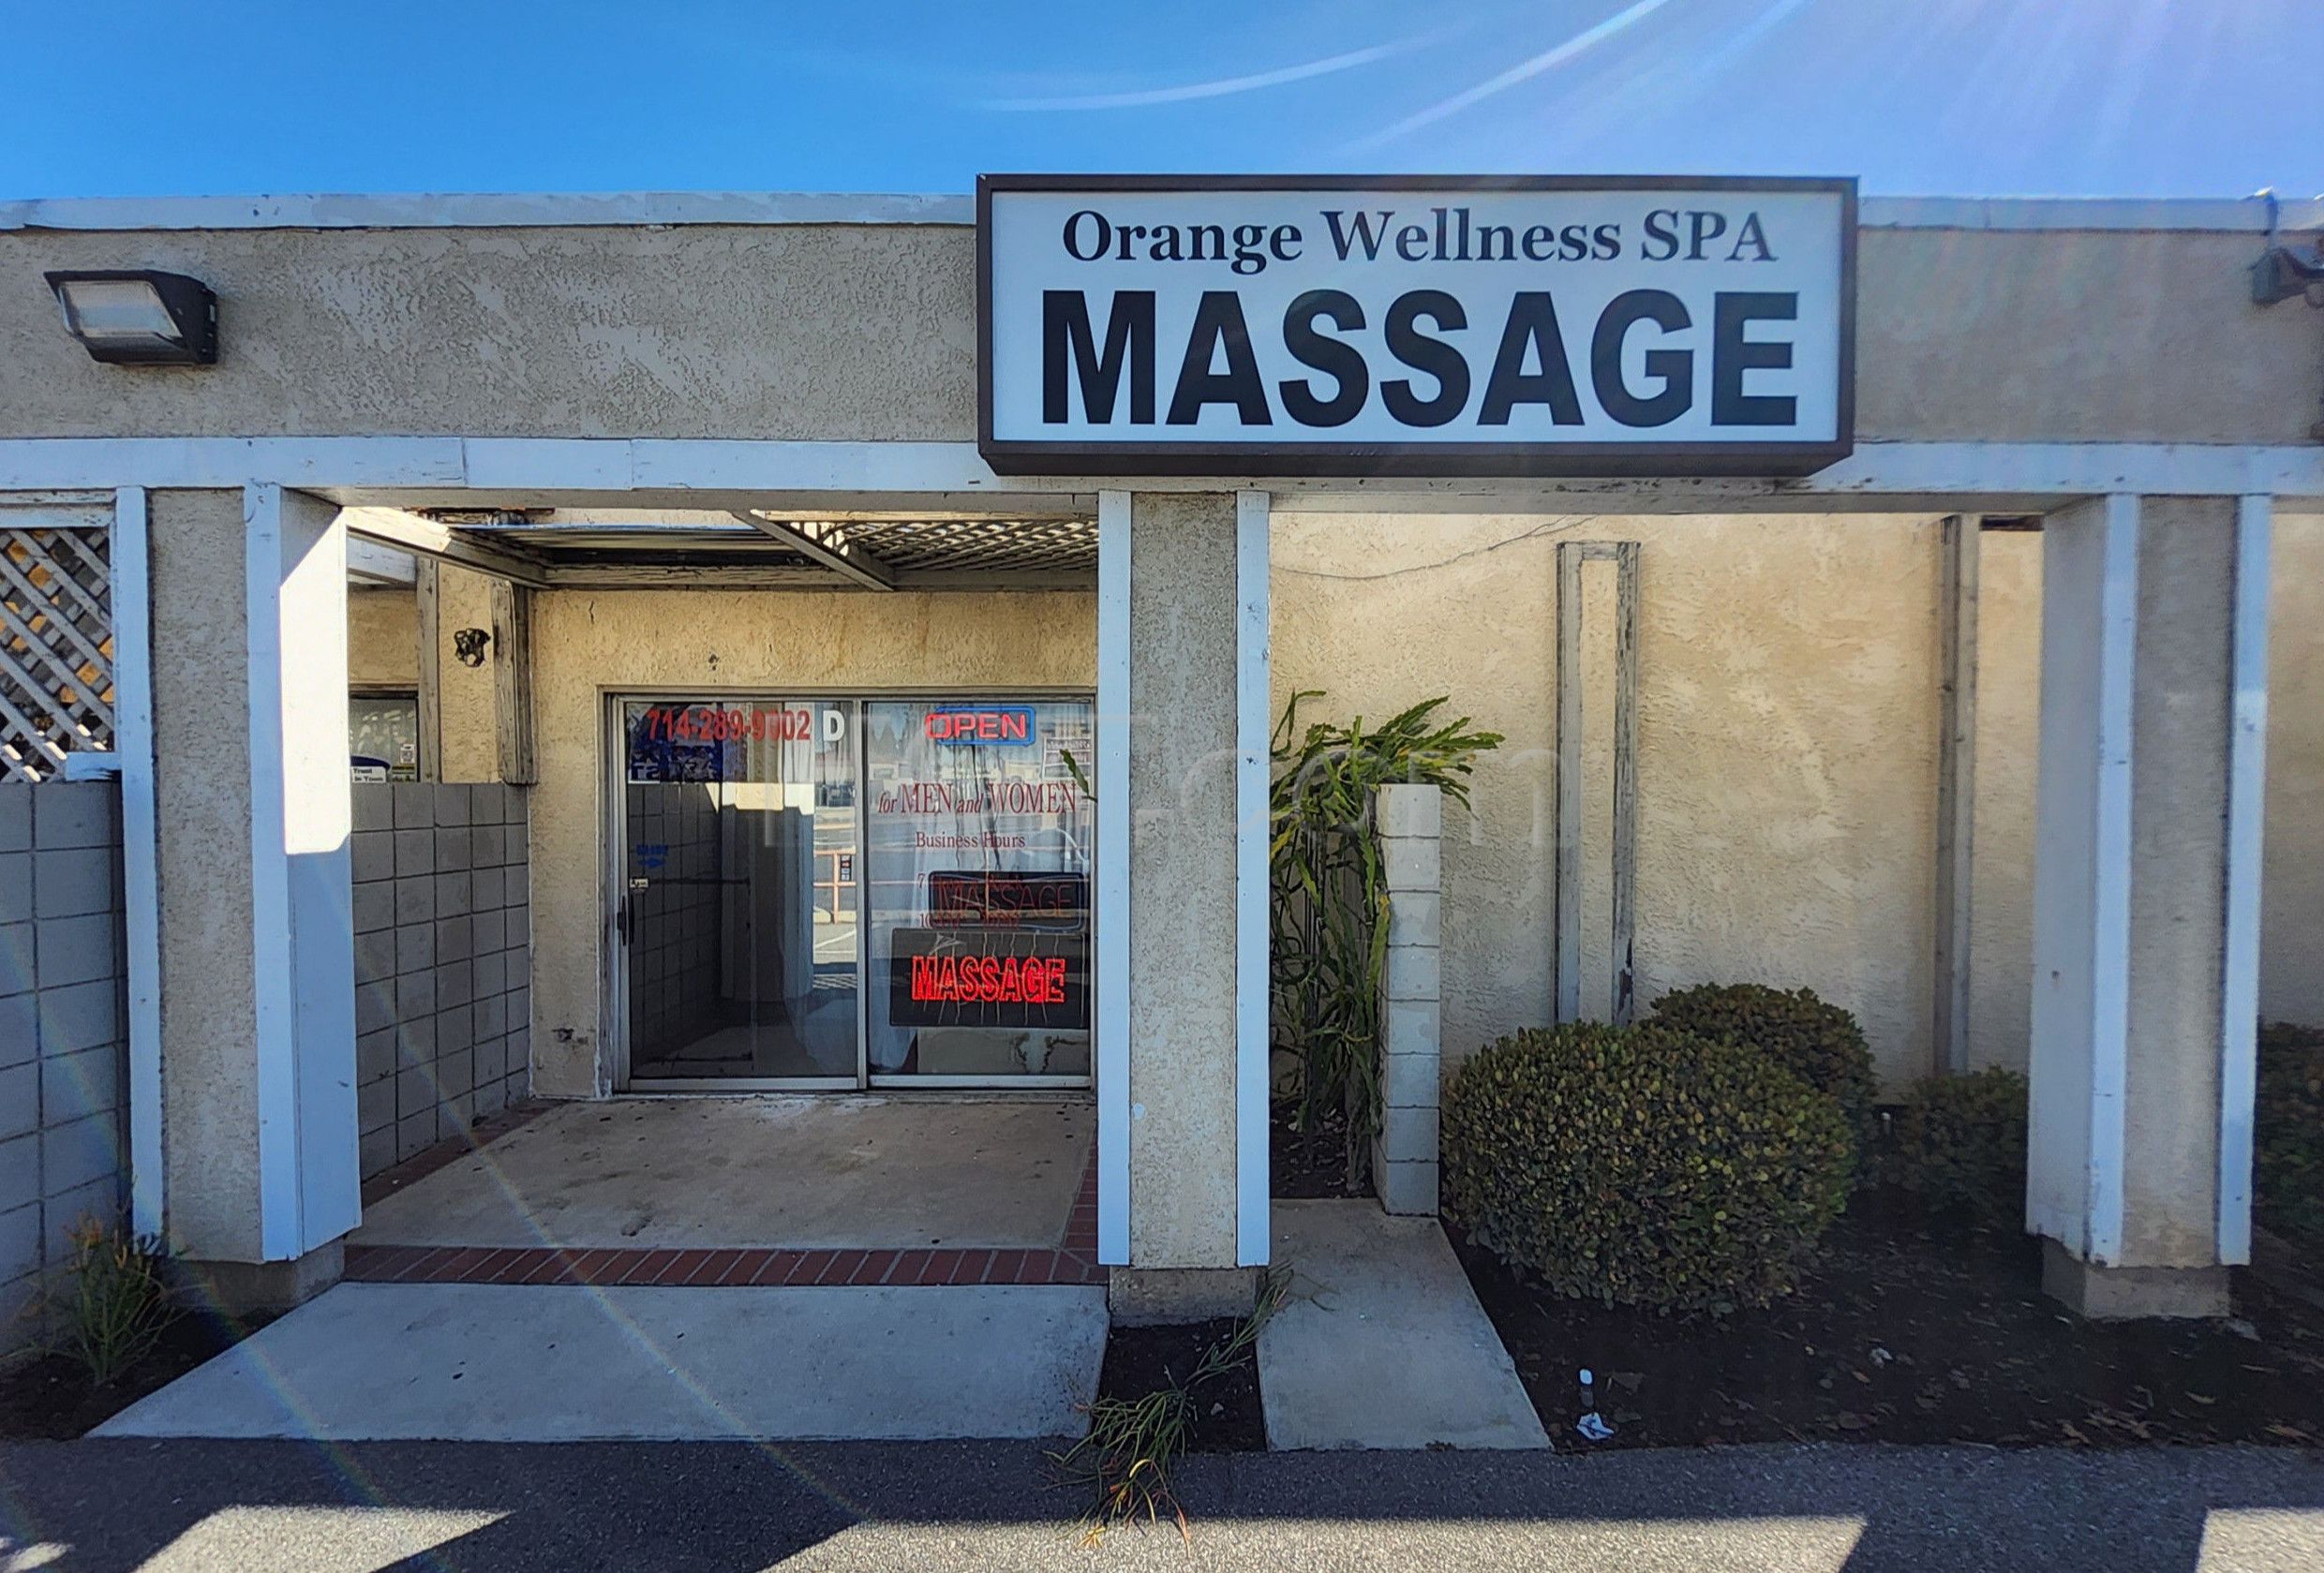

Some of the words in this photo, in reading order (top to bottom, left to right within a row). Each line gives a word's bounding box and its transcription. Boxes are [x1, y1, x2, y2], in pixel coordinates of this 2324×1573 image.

[1062, 209, 1304, 276] Orange
[1320, 208, 1621, 263] Wellness
[1640, 210, 1780, 262] SPA
[1041, 289, 1799, 428] MASSAGE
[647, 709, 812, 742] 714-289-9002
[822, 709, 845, 742] D
[924, 712, 1027, 739] OPEN
[877, 792, 898, 814] for
[901, 782, 954, 813] MEN
[956, 794, 982, 813] and
[989, 782, 1077, 813] WOMEN
[915, 830, 979, 848] Business
[983, 830, 1026, 848] Hours
[911, 955, 1066, 1003] MASSAGE
